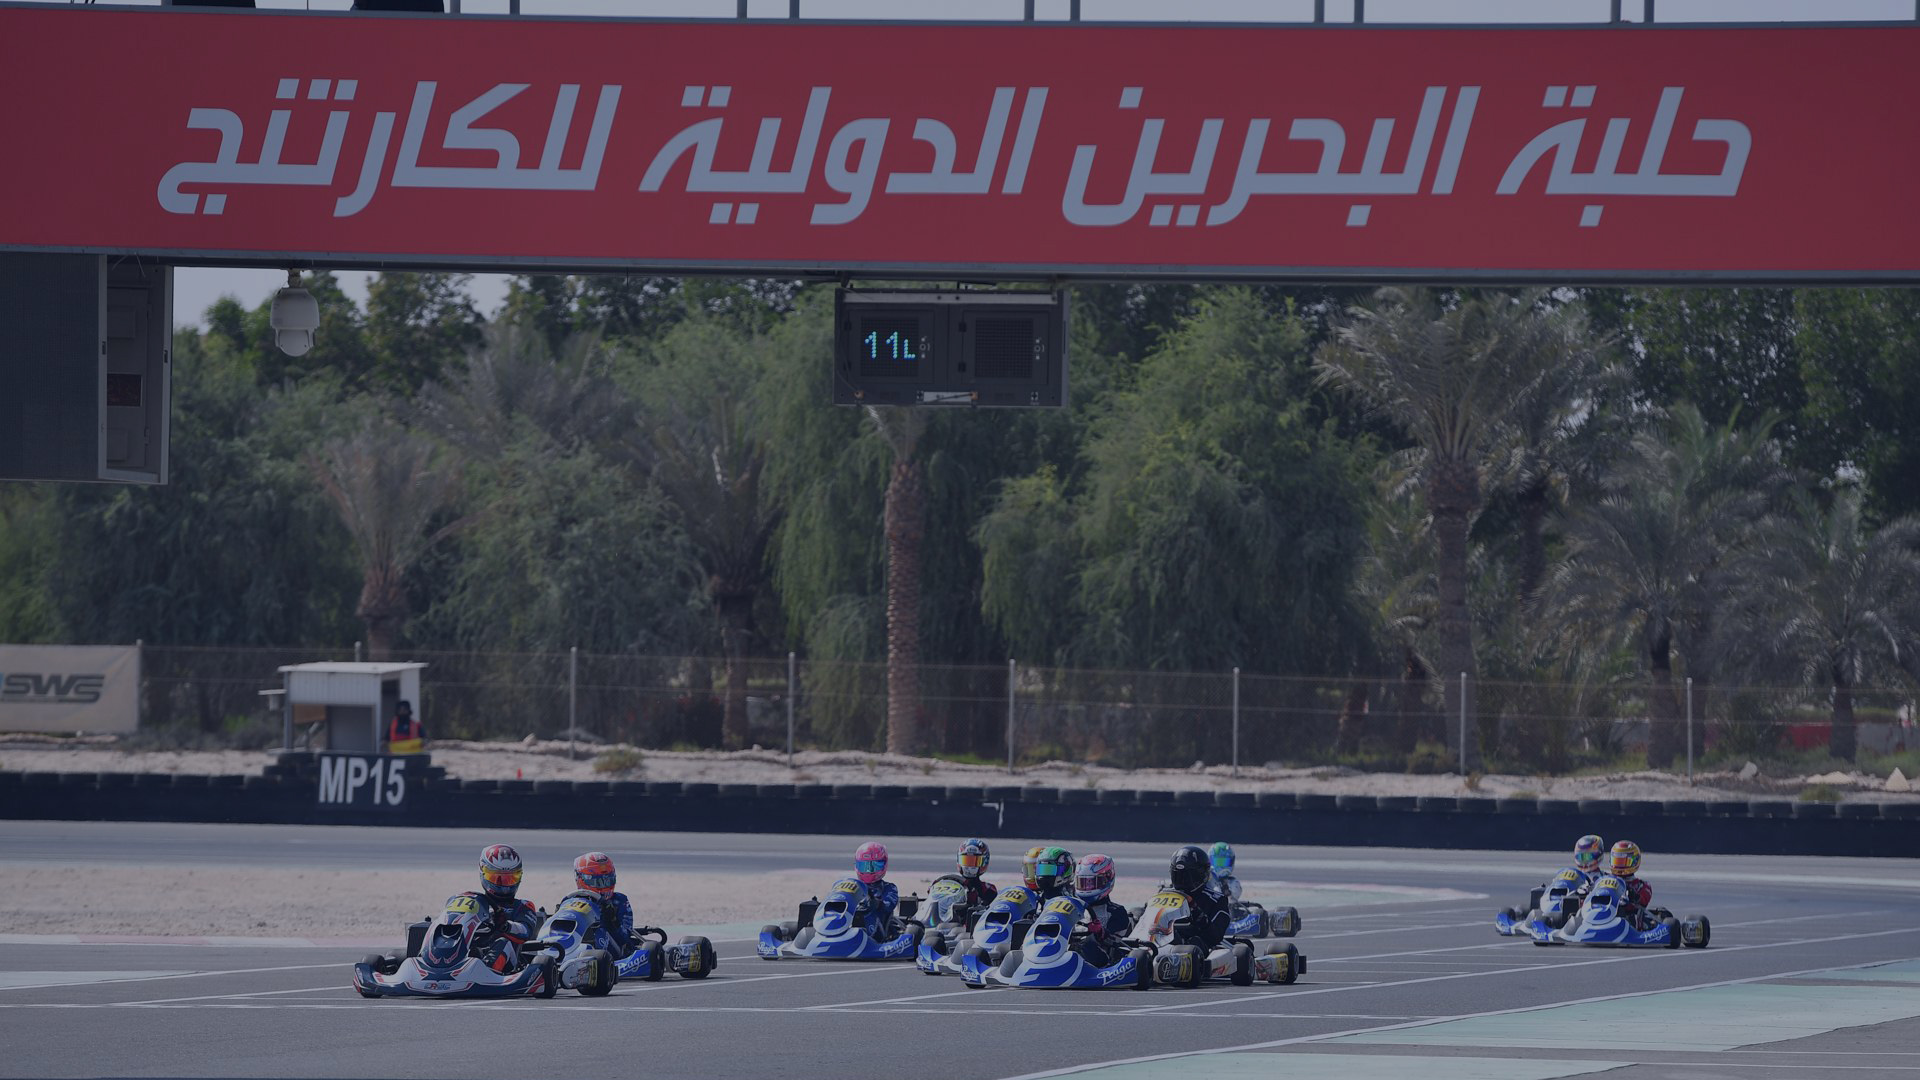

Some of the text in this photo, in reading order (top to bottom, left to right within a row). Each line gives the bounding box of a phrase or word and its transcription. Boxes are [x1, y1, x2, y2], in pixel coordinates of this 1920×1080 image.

[156, 78, 1753, 227] حلبة البحرين الدولية للكارتنج
[2, 673, 105, 704] SWS
[318, 755, 406, 806] MP15
[1152, 896, 1181, 908] 245
[878, 936, 914, 959] Praga
[1639, 926, 1670, 944] Praga
[616, 953, 649, 978] Praga
[1096, 960, 1136, 987] Praga
